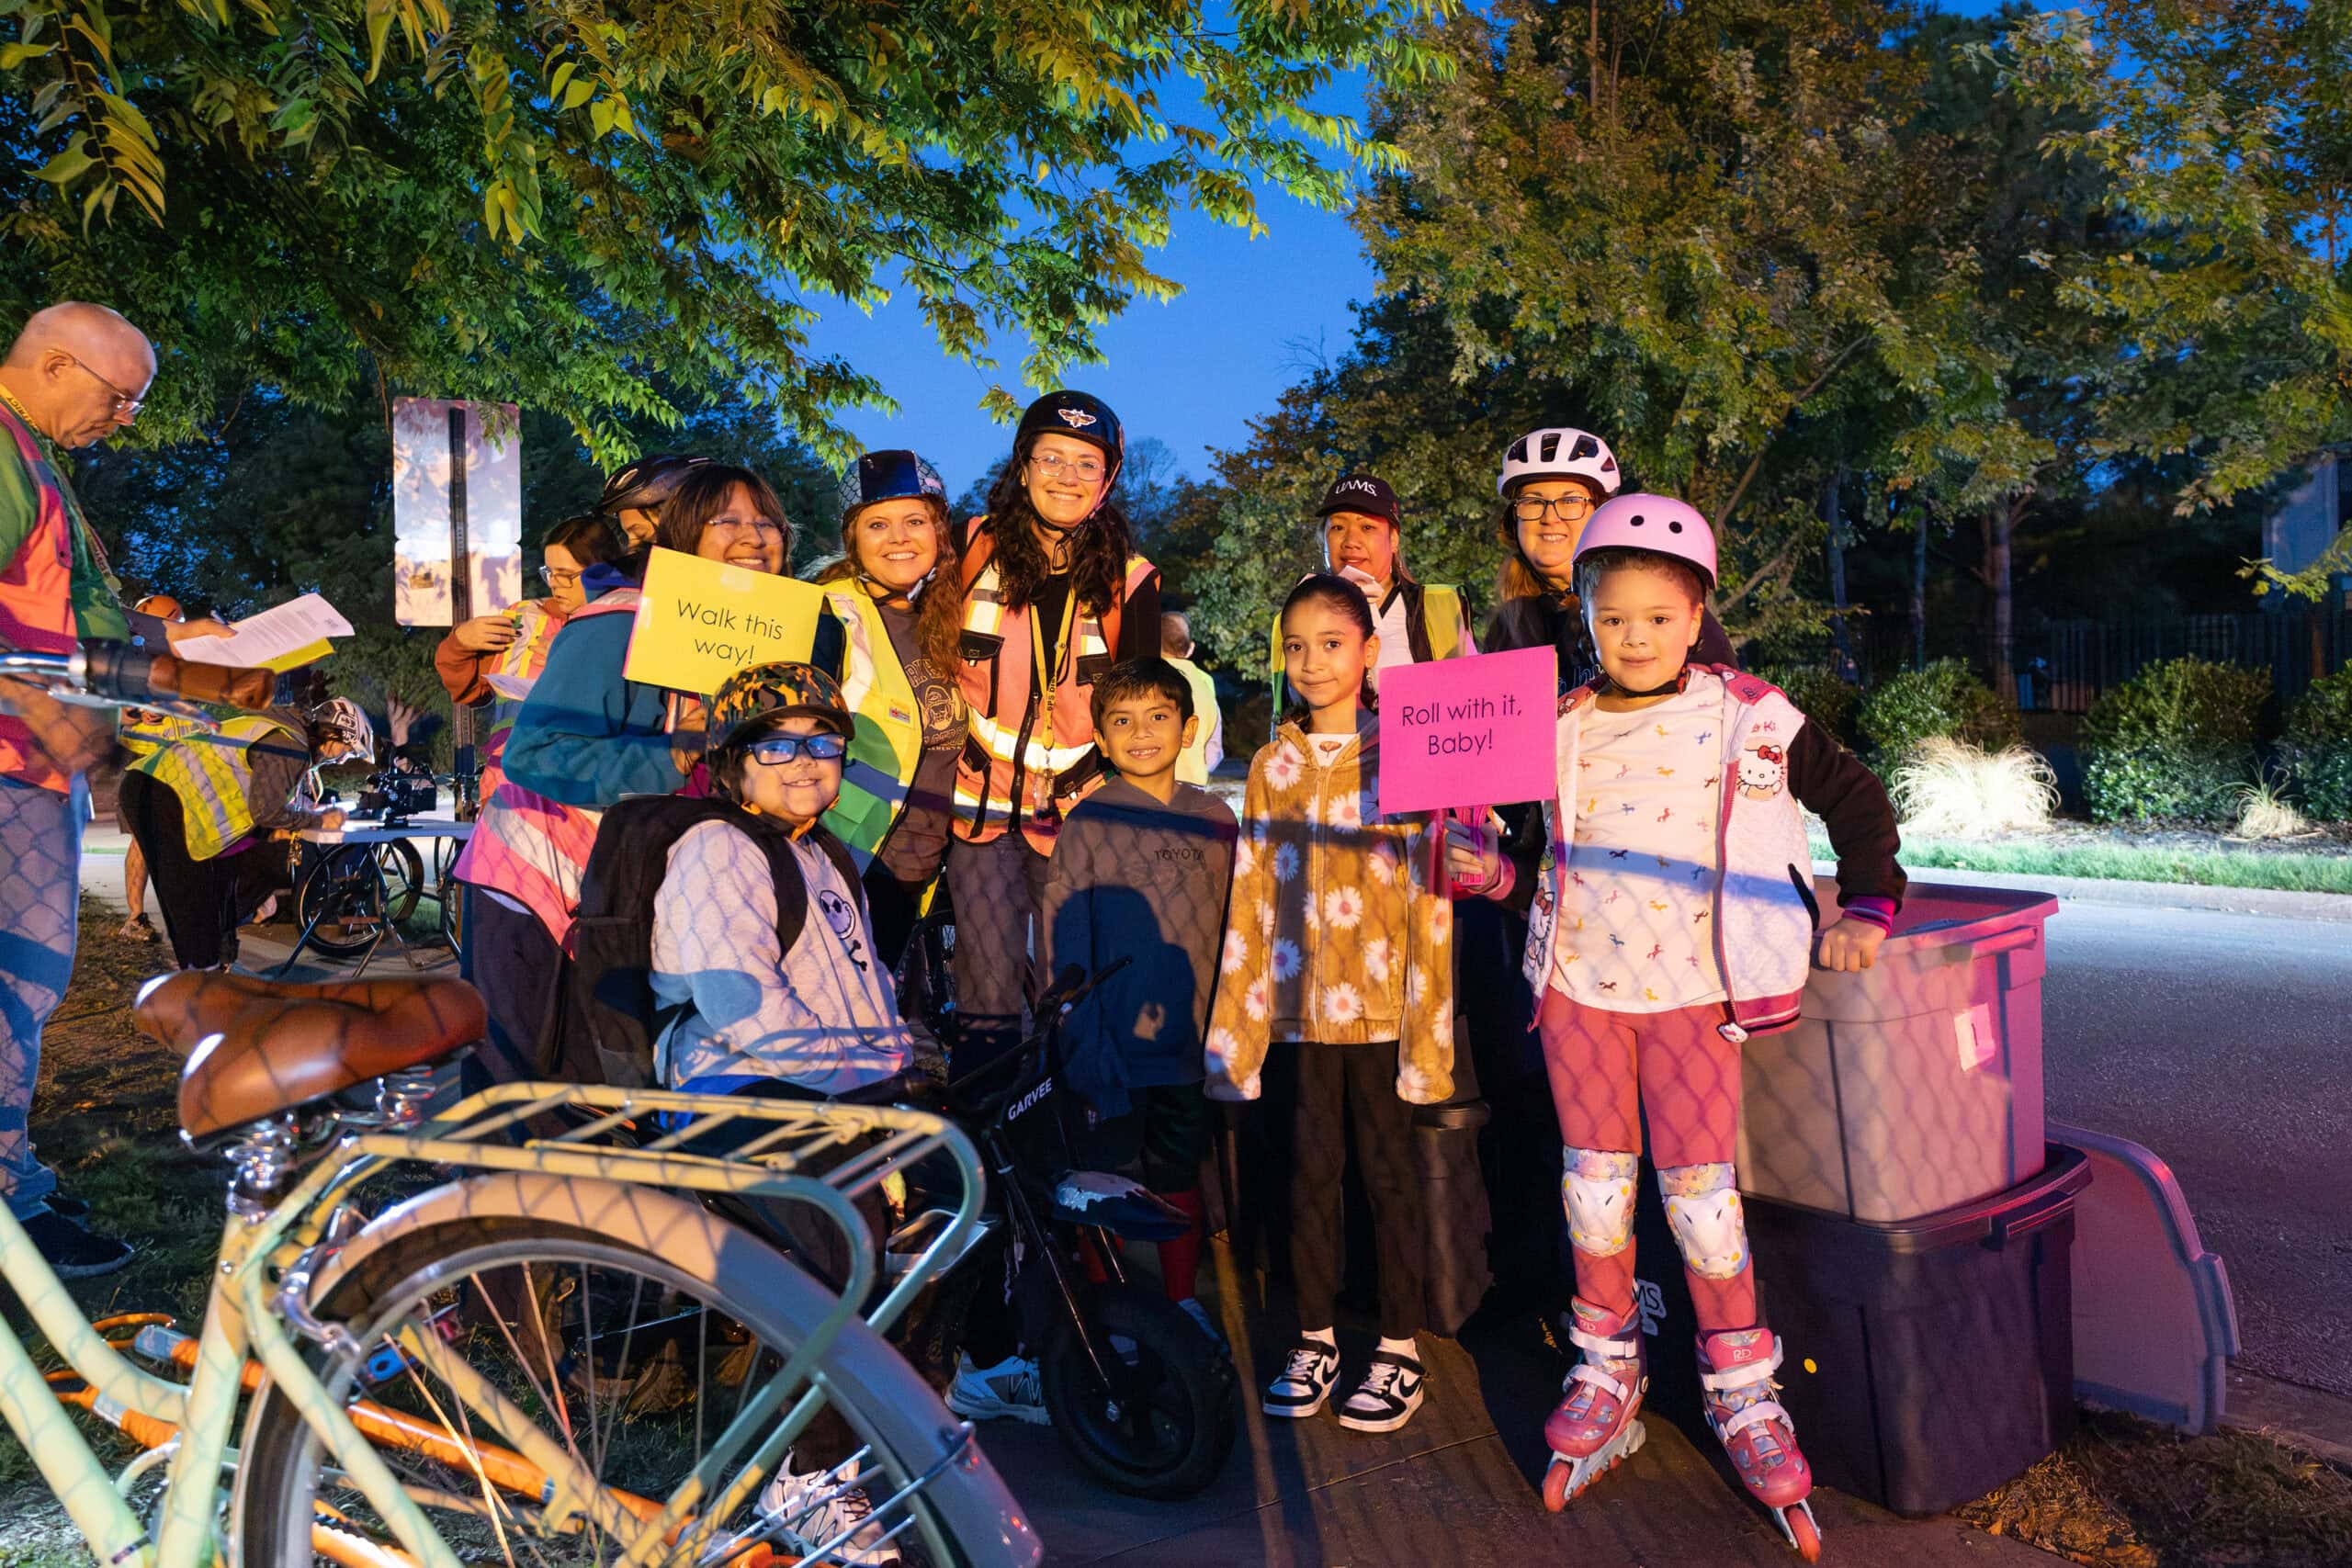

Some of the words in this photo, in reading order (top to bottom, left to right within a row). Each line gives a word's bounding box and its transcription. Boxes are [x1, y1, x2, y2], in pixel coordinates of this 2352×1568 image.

[678, 598, 737, 630] Walk
[745, 614, 783, 640] this
[695, 638, 754, 667] way!
[1402, 702, 1440, 726] Roll
[1447, 697, 1494, 720] with
[1503, 694, 1521, 716] it,
[1429, 728, 1492, 756] Baby!
[1154, 848, 1205, 861] TOYOTA
[1008, 1077, 1052, 1121] GARVEE
